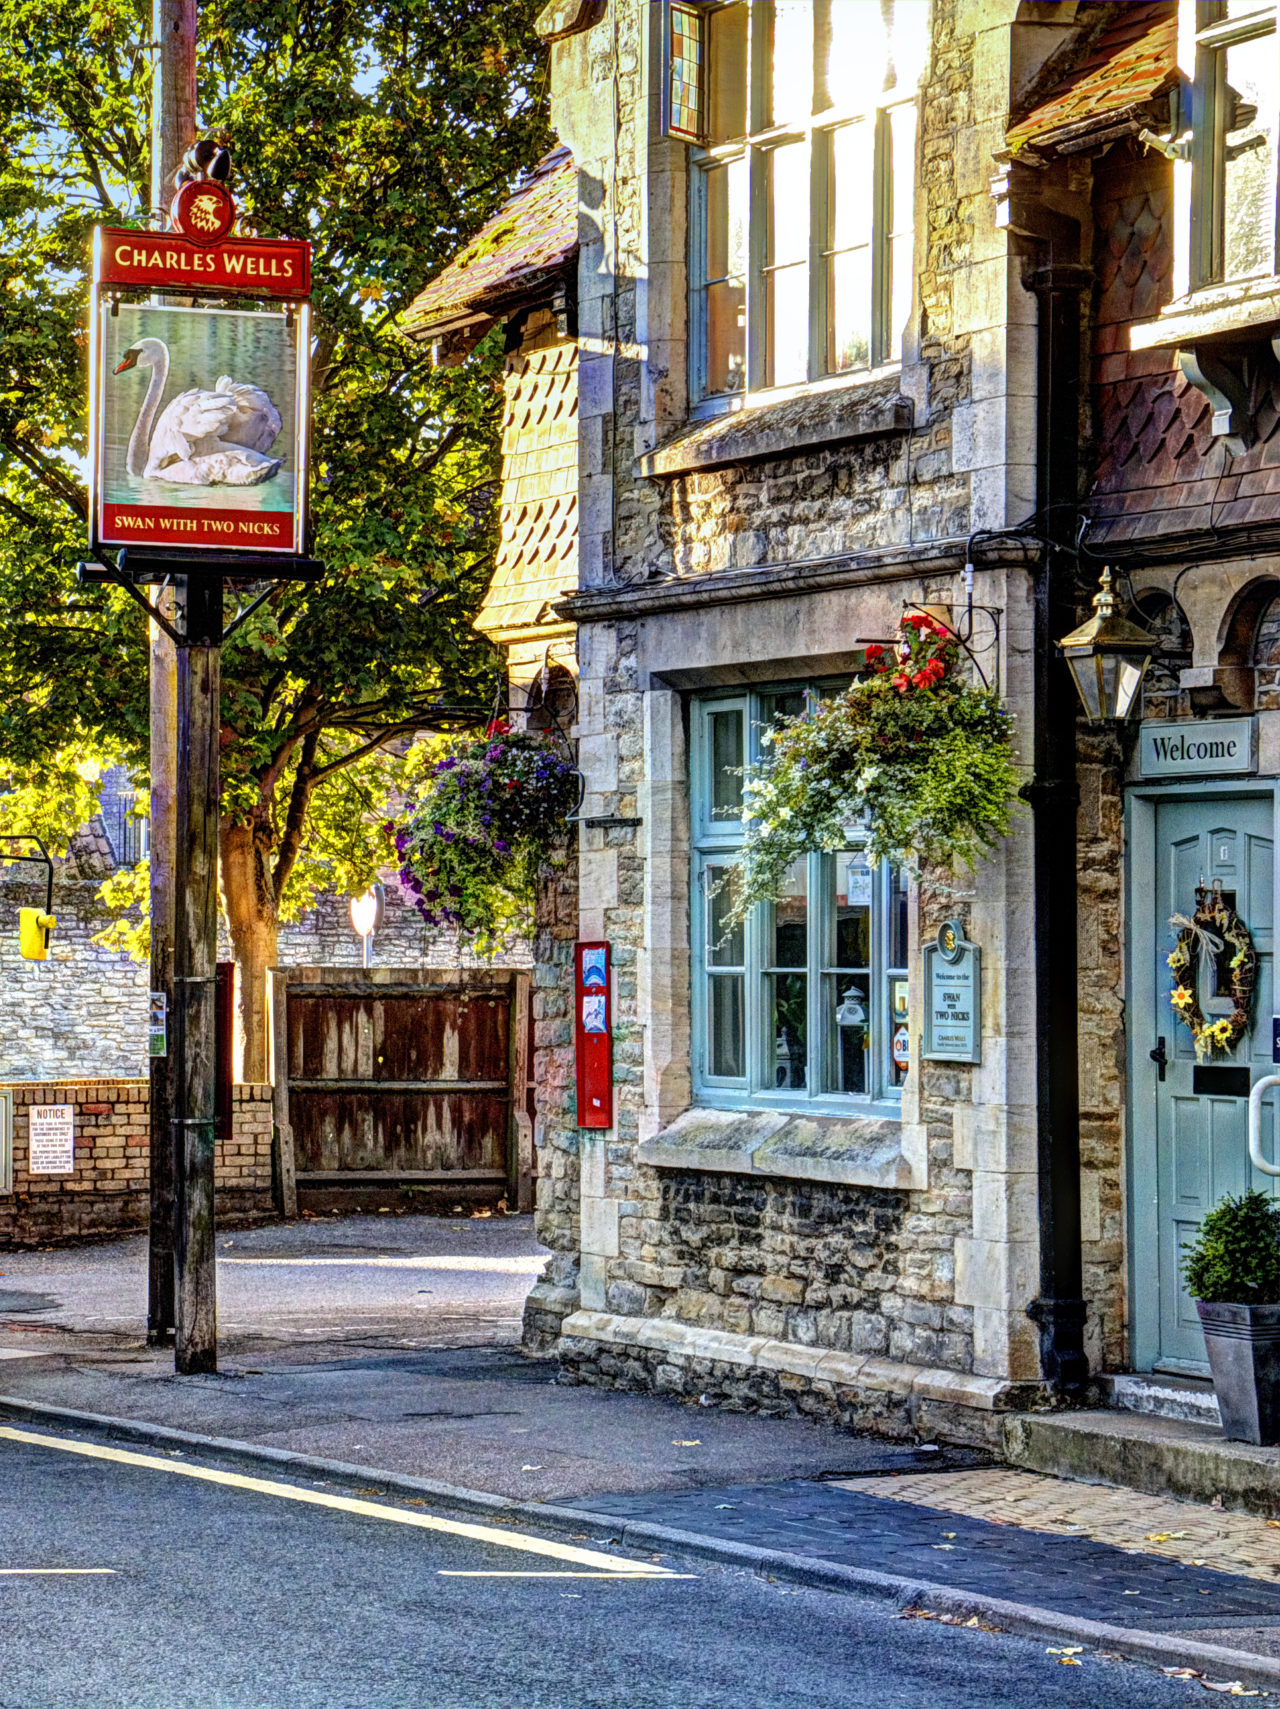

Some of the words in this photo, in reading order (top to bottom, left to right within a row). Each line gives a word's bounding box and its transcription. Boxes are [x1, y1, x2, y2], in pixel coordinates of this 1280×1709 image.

[114, 245, 216, 272] CHARLES
[222, 253, 293, 277] WELLS
[114, 516, 156, 530] SWAN
[159, 518, 198, 531] WITH
[201, 519, 235, 533] TWO
[238, 522, 280, 535] NICKS
[1152, 735, 1238, 762] Welcome
[942, 993, 961, 1002] SWAN
[934, 1011, 950, 1021] TWO
[950, 1011, 970, 1021] NICKS
[36, 1108, 66, 1119] NOTICE
